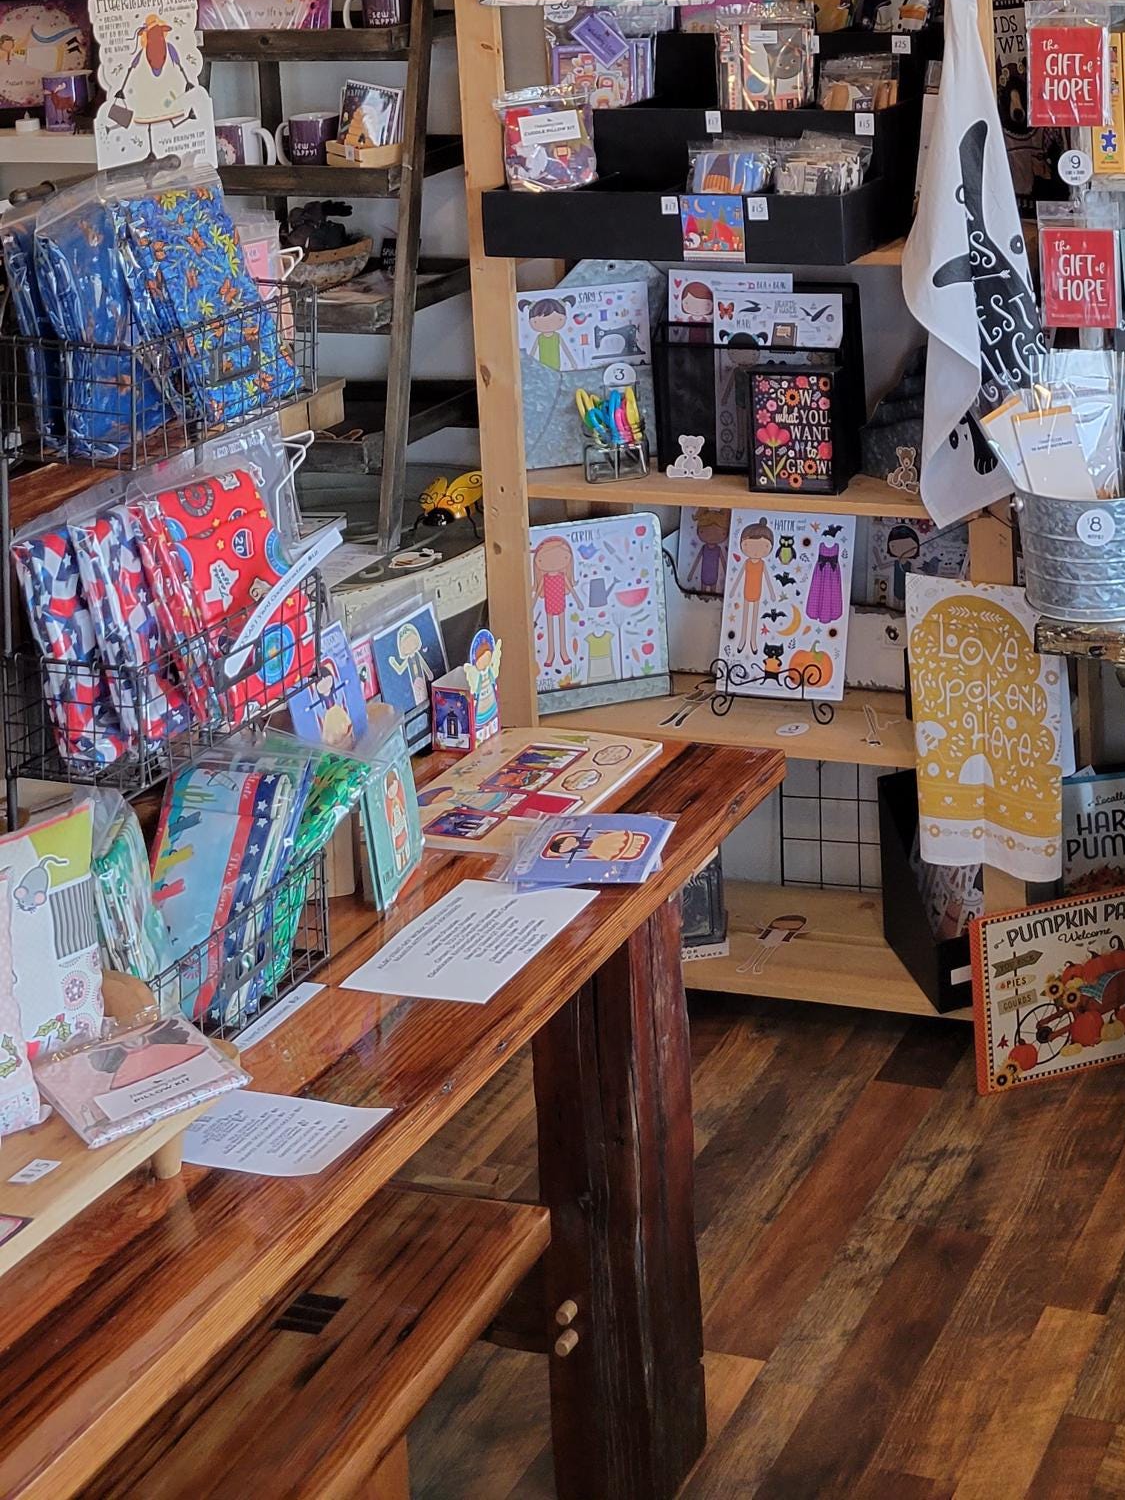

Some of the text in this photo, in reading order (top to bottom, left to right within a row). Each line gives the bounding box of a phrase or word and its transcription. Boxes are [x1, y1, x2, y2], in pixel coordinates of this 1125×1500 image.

[1041, 39, 1060, 51] the
[1045, 53, 1084, 76] GIFT
[1044, 77, 1094, 101] HOPE
[1053, 240, 1072, 255] the
[1059, 254, 1095, 277] GIFT
[1058, 279, 1106, 302] HOPE
[775, 405, 828, 424] what YOU
[790, 426, 831, 441] WANT
[806, 441, 818, 458] to
[786, 459, 832, 474] GROW!
[1089, 516, 1102, 532] 8
[234, 536, 244, 551] 20
[1007, 905, 1098, 947] PUMPKIN
[1058, 927, 1113, 944] Welcome
[1006, 977, 1027, 988] PIES
[1003, 994, 1032, 1011] GOURDS
[172, 1076, 191, 1091] KIT
